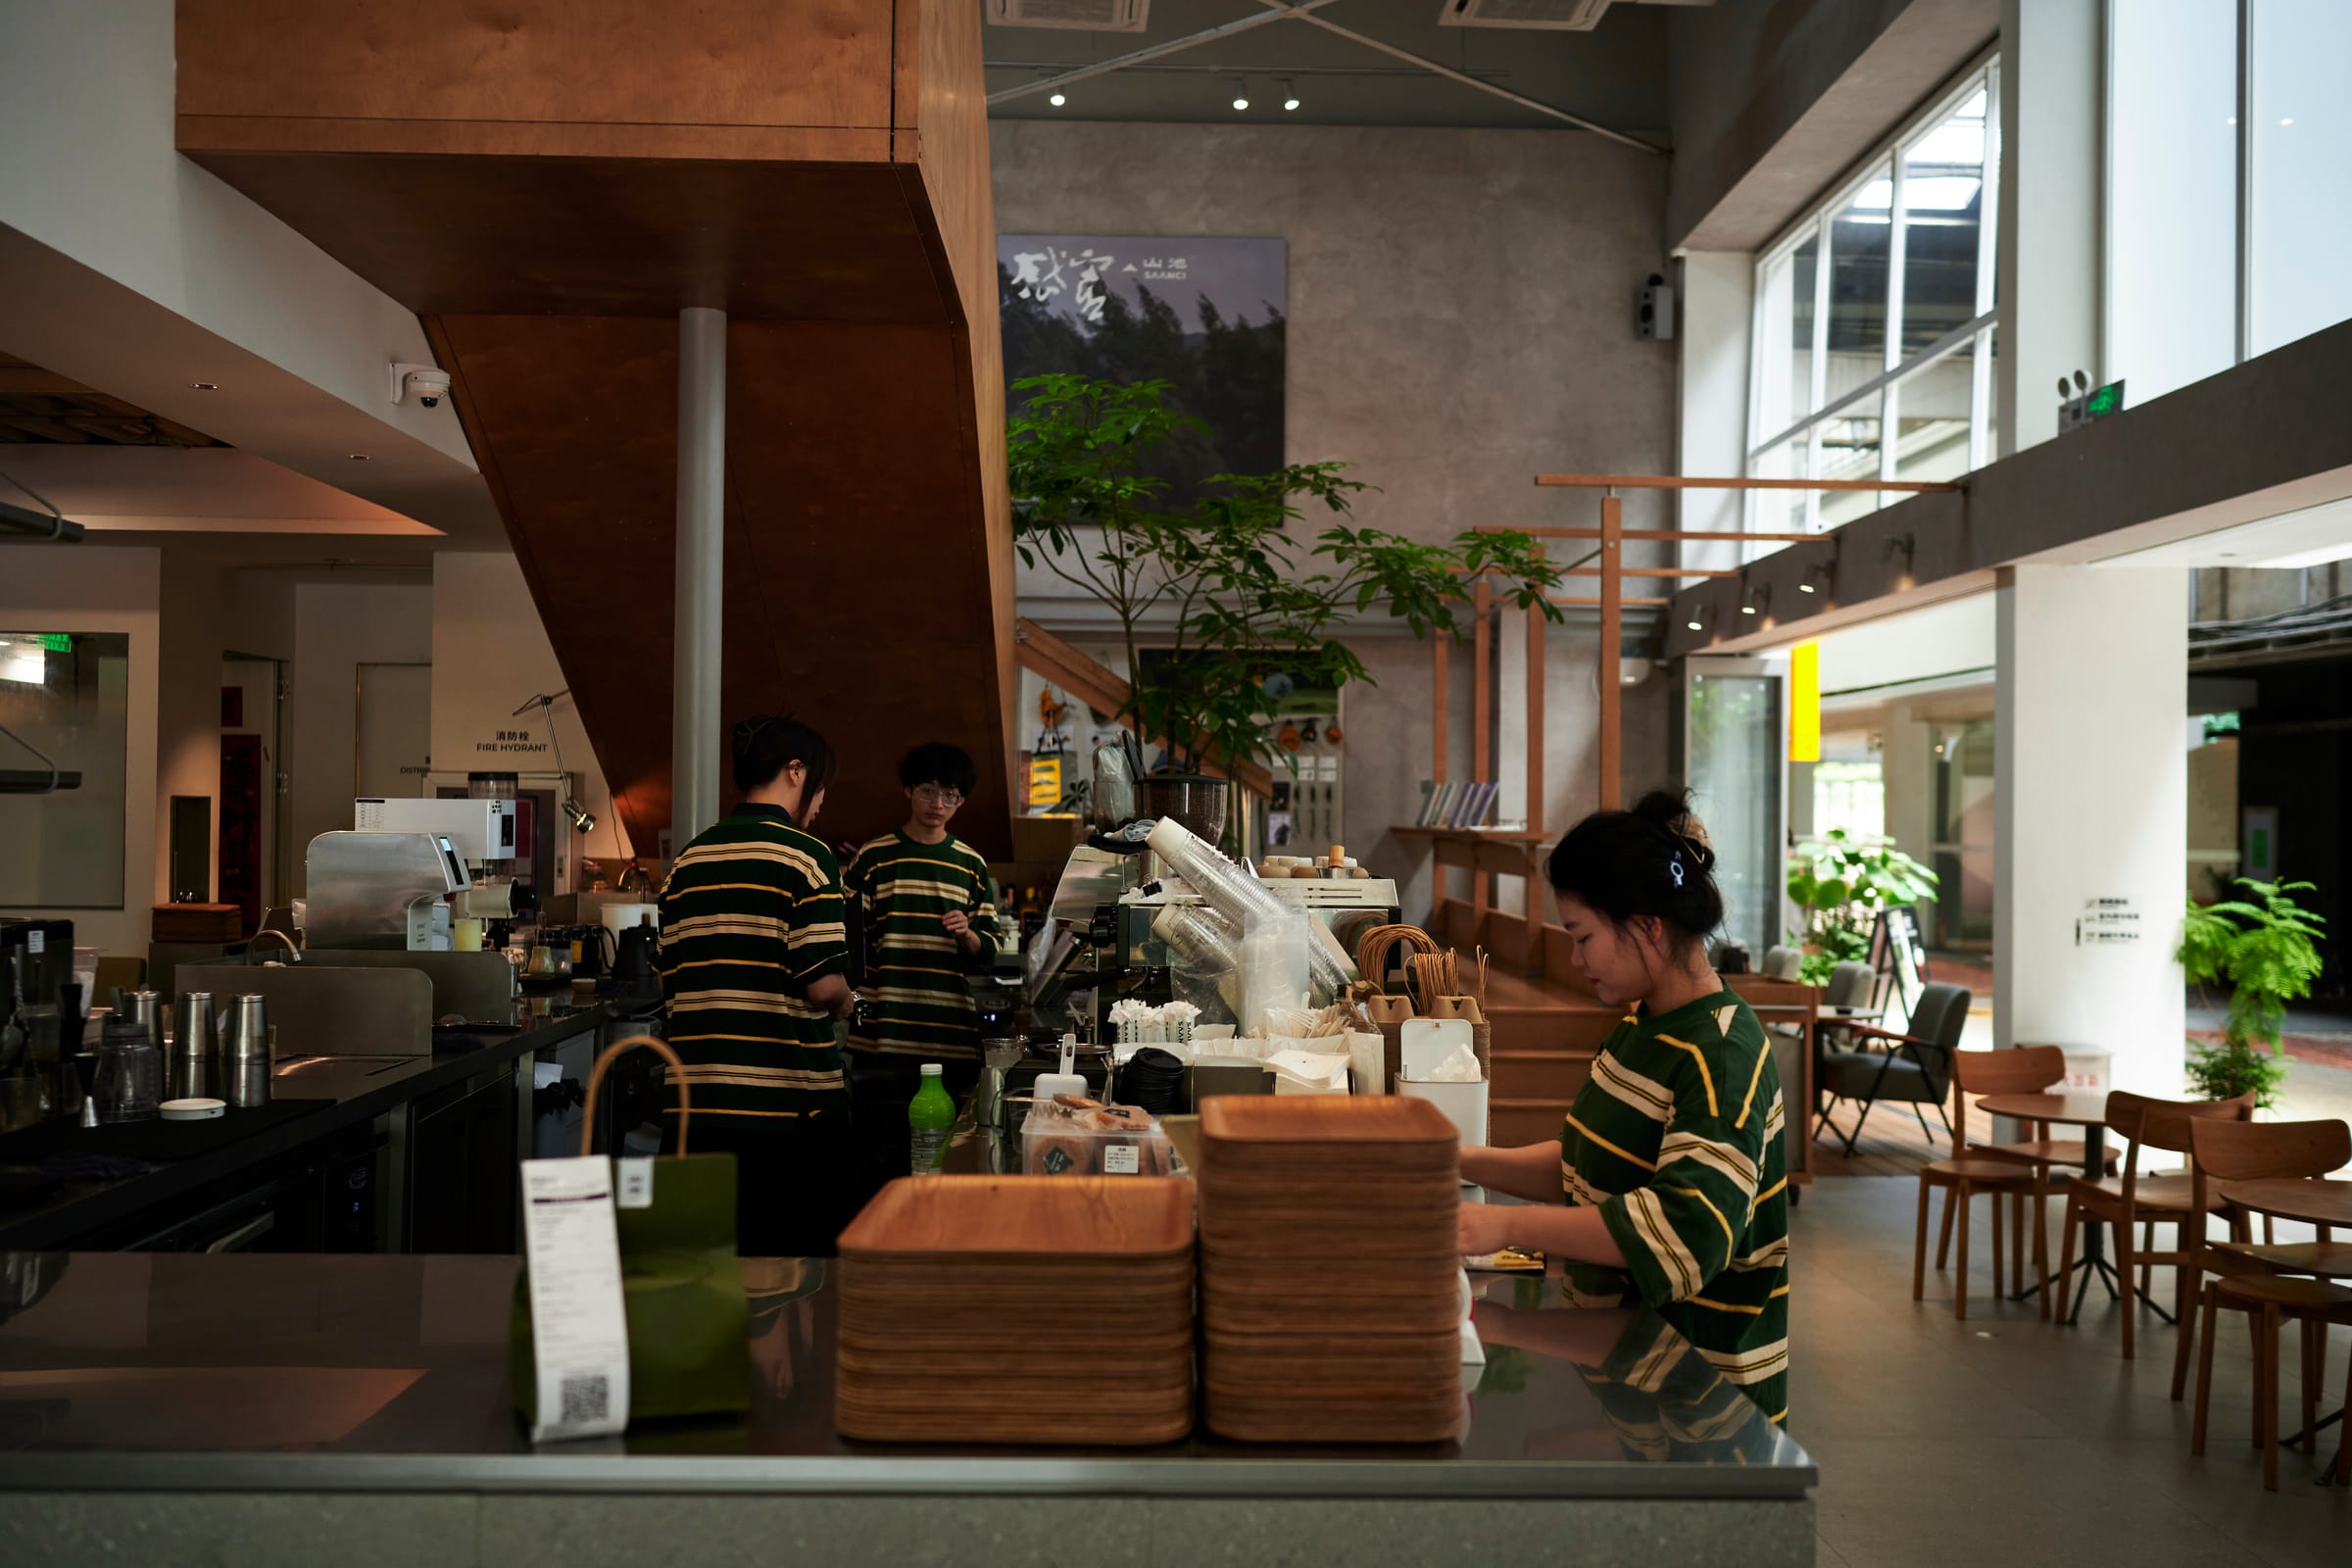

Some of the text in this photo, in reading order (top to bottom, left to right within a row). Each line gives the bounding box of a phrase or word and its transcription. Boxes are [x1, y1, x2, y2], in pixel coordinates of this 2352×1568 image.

[496, 730, 529, 741] 消防栓
[476, 744, 548, 753] FIRE HYDRANT
